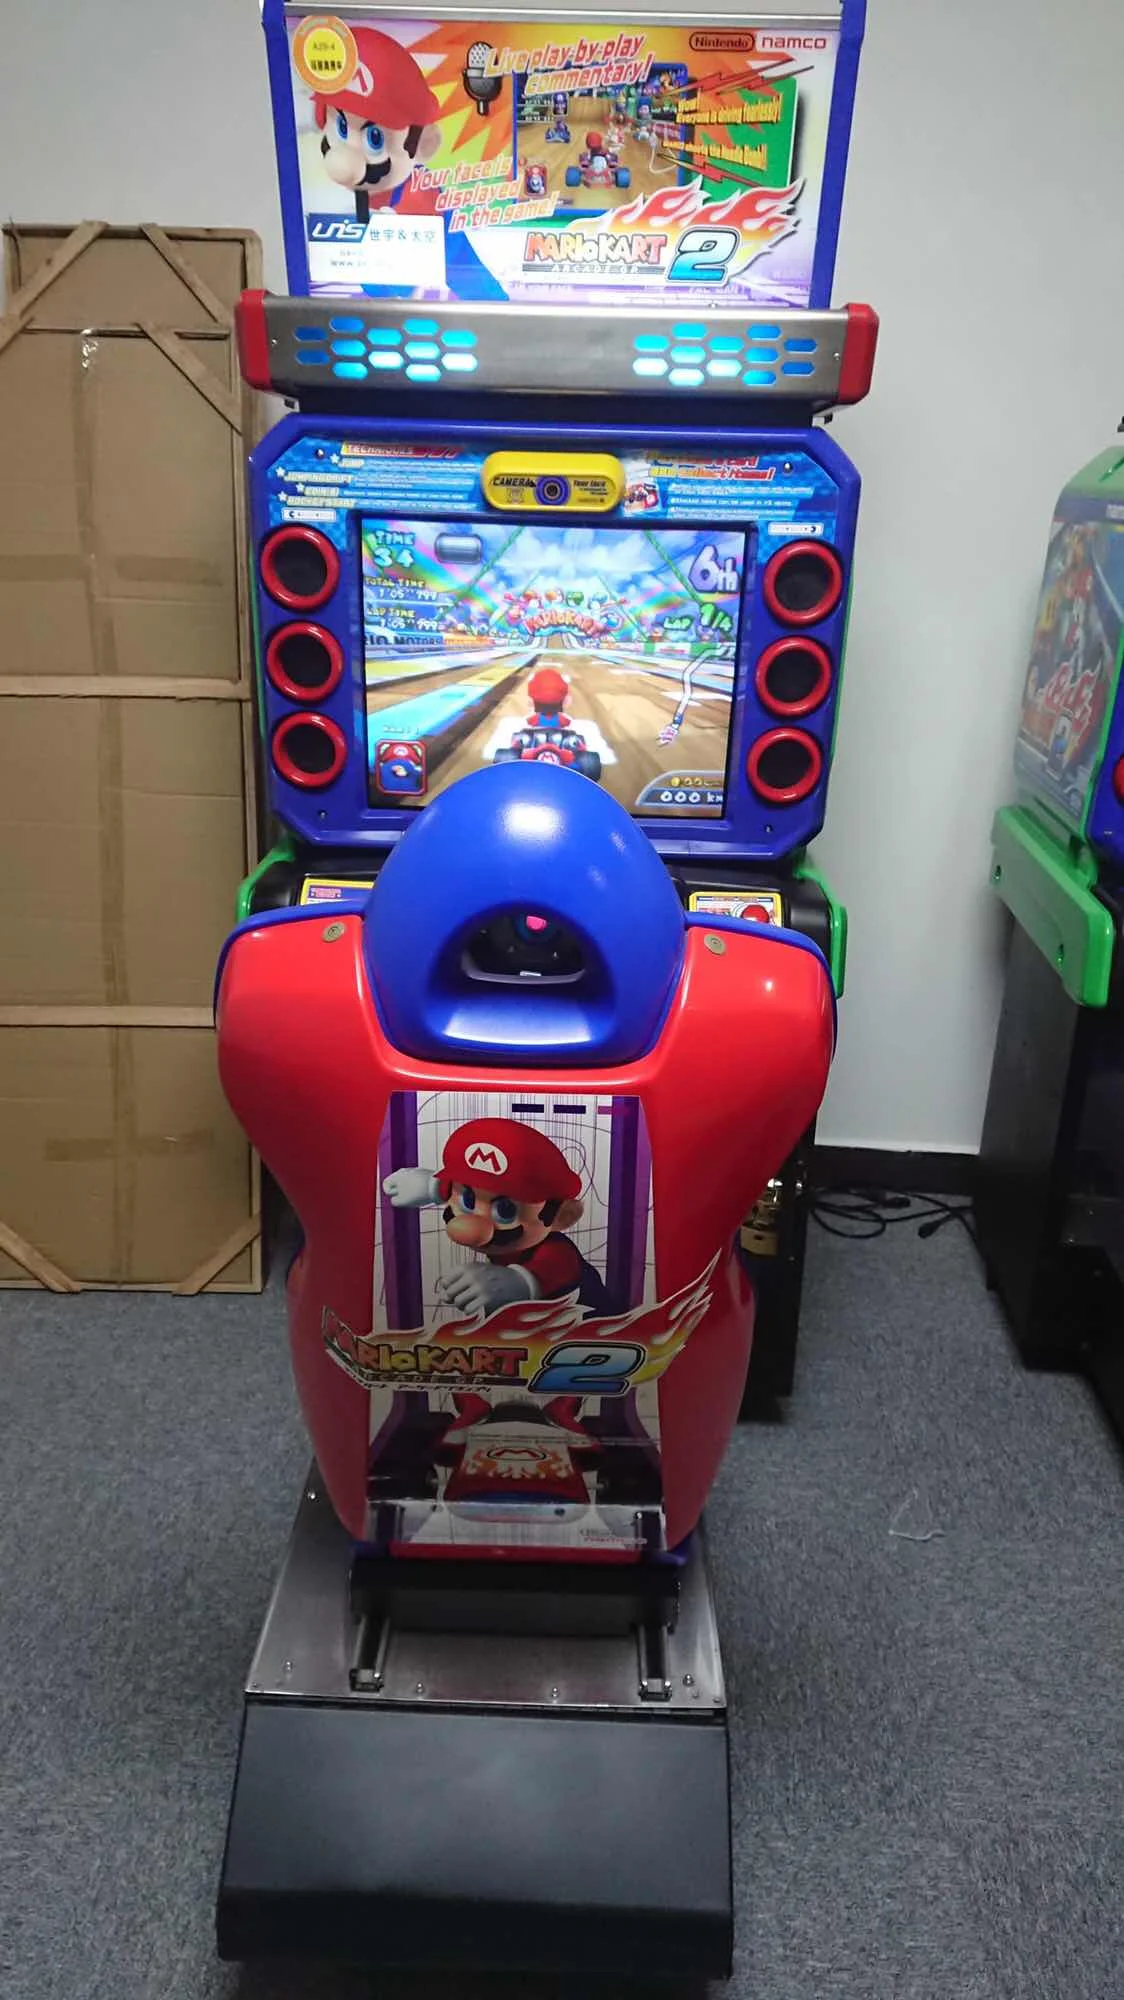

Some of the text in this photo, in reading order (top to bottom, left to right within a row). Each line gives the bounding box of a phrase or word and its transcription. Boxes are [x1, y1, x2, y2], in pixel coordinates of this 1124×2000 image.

[694, 36, 827, 50] Nintendo namco
[484, 47, 529, 78] Live
[525, 52, 655, 95] commentary!
[411, 166, 453, 192] Your
[454, 159, 494, 184] face
[436, 180, 522, 210] displayed
[450, 208, 468, 231] in
[472, 205, 500, 227] the
[666, 226, 742, 284] 2
[491, 476, 531, 487] CAMERA
[375, 530, 416, 545] TIME
[374, 547, 414, 567] 34
[688, 544, 739, 592] 6th
[398, 579, 425, 588] TIME
[389, 608, 416, 618] TIME
[660, 790, 701, 803] 000
[528, 1340, 647, 1396] 2
